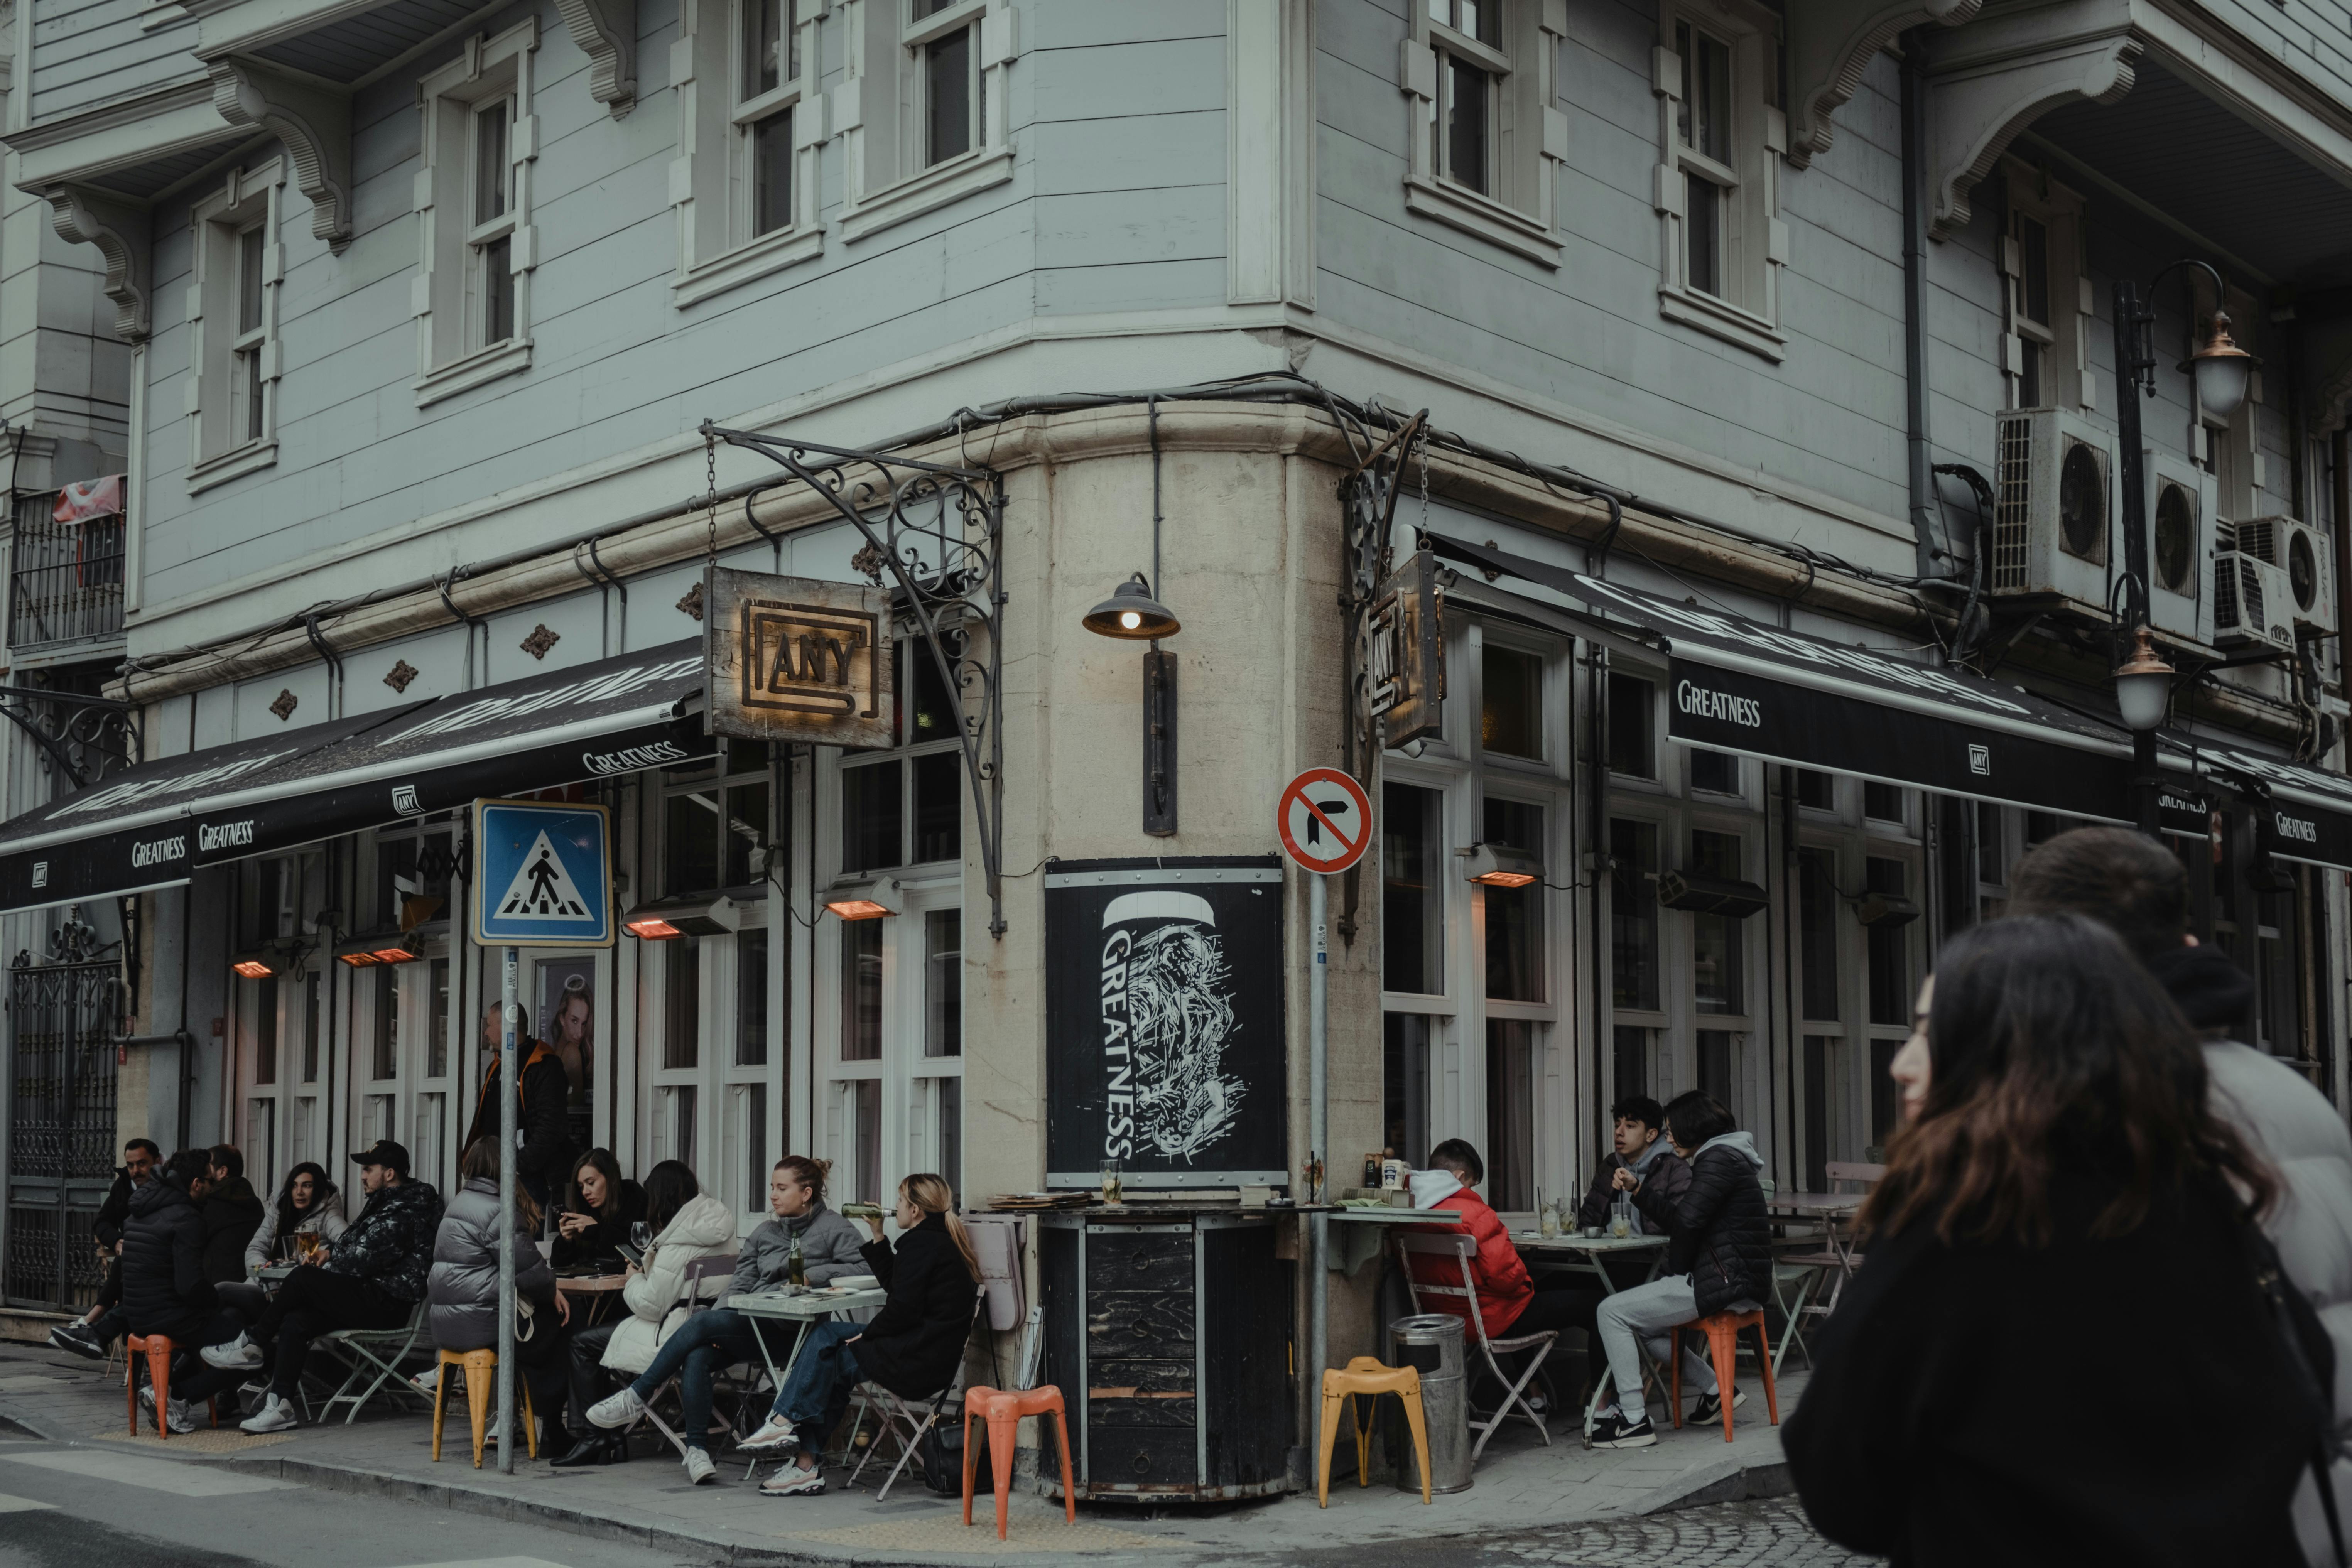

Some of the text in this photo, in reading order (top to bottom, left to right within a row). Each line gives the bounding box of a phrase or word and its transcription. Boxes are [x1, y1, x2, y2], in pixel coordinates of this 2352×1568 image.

[768, 632, 856, 690] ANY
[1678, 679, 1761, 727] GREATNESS
[583, 741, 688, 775] GREATNESS
[199, 820, 254, 851] GREATNESS
[2276, 811, 2316, 843] GREATNESS
[132, 835, 185, 868] GREATNESS
[1101, 929, 1134, 1160] GREATNESS
